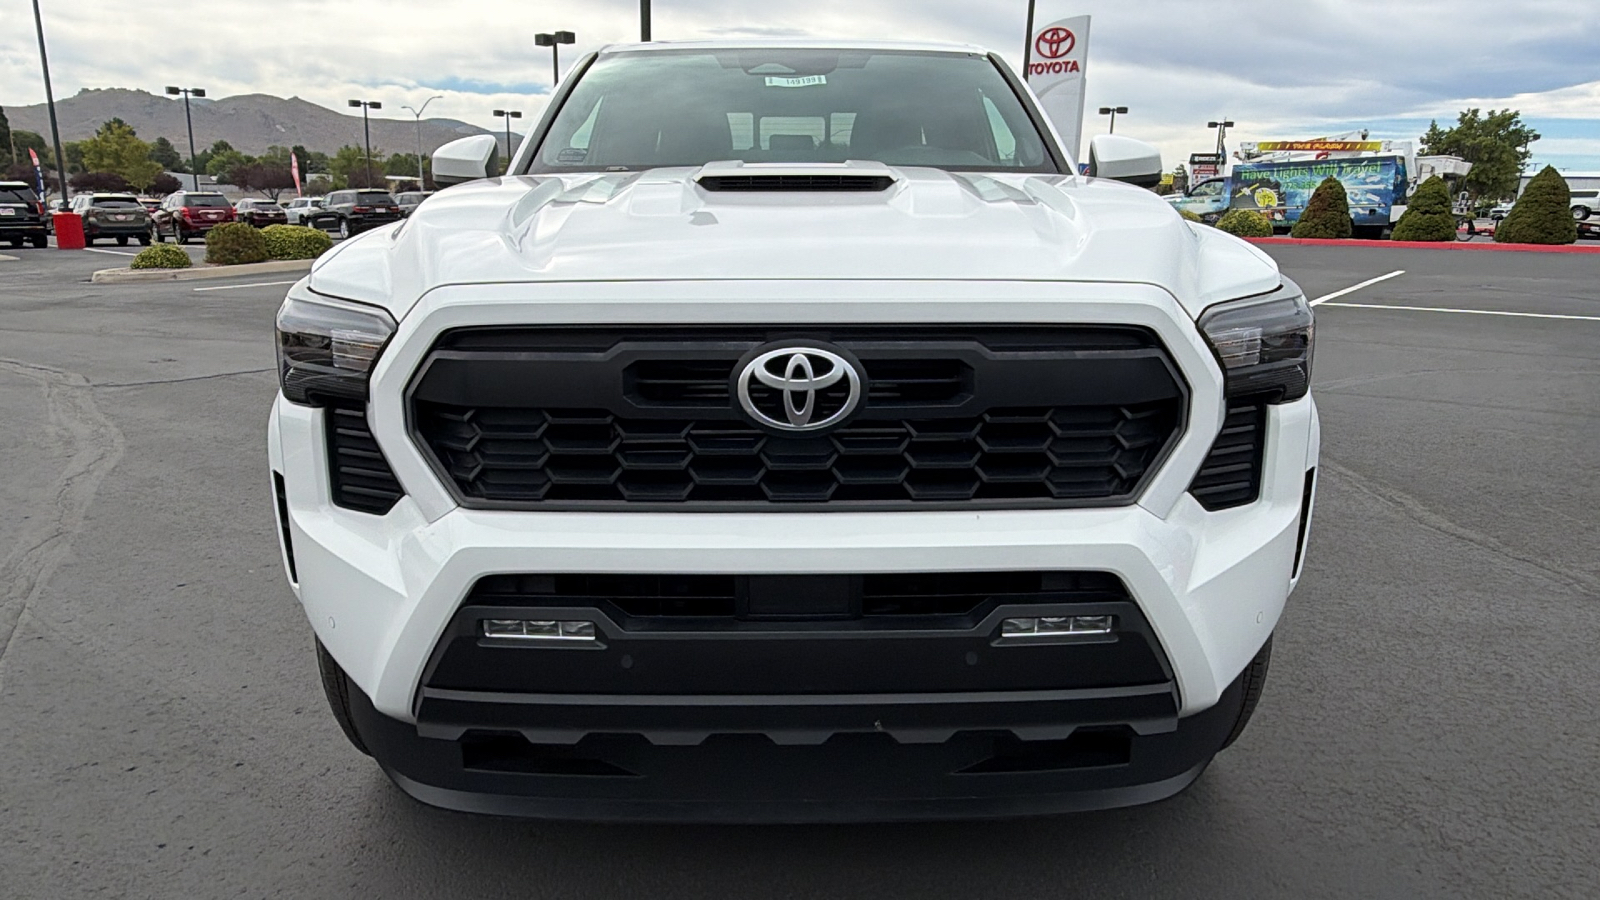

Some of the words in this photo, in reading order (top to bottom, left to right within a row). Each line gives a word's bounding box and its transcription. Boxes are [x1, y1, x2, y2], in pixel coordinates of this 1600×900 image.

[1029, 60, 1080, 75] TOYOTA
[1241, 169, 1270, 180] Have
[1274, 167, 1308, 180] Lights
[1341, 161, 1381, 177] Travel
